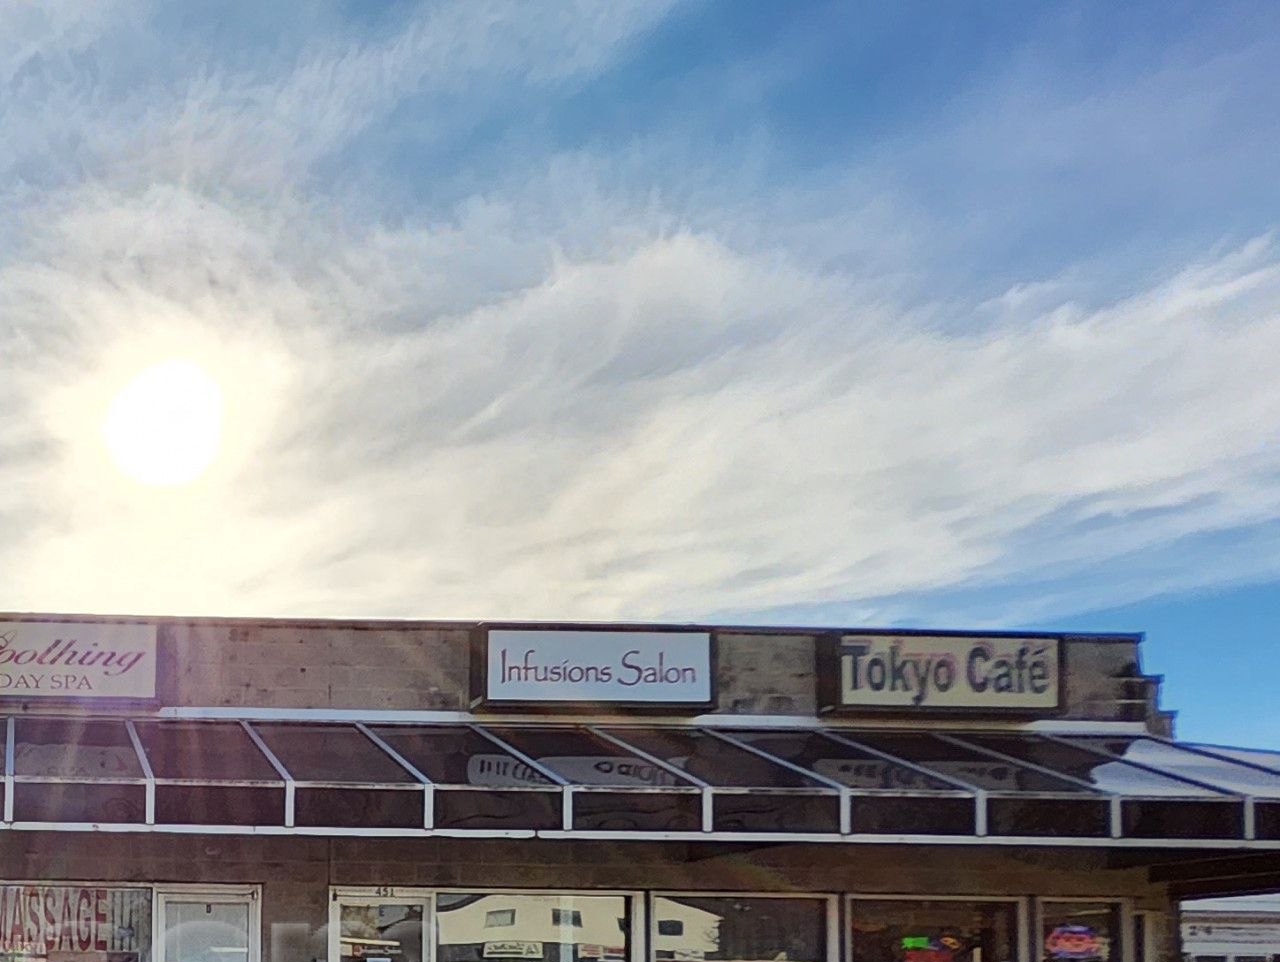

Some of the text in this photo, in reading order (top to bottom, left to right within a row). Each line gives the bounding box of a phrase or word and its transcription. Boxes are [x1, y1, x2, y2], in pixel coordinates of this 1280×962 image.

[501, 648, 696, 686] Infusions Salon
[840, 641, 1050, 706] Tokyo Café
[50, 674, 93, 690] SPA
[375, 887, 394, 897] 451
